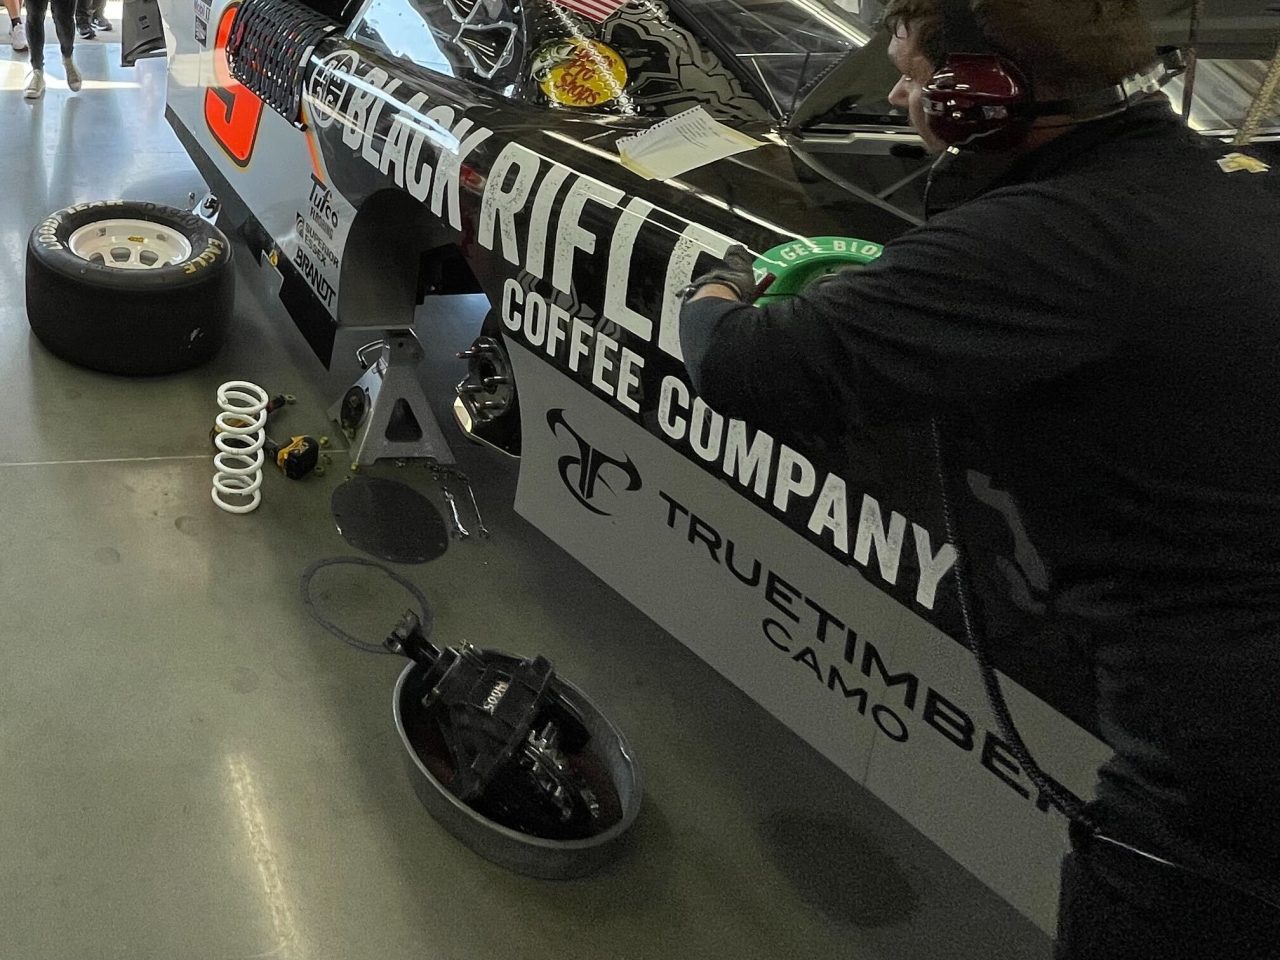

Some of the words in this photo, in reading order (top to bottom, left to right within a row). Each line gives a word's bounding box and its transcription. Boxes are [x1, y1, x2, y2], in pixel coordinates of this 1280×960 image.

[342, 66, 494, 232] BLACK
[304, 221, 340, 269] SUPERIOR
[309, 172, 339, 229] Tufco
[293, 245, 337, 308] BRANDT
[304, 233, 327, 268] ESSEX
[500, 278, 647, 414] COFFEE
[656, 375, 958, 610] COMPANY
[658, 489, 1066, 814] TRUETIMBE
[762, 616, 911, 745] CAMO
